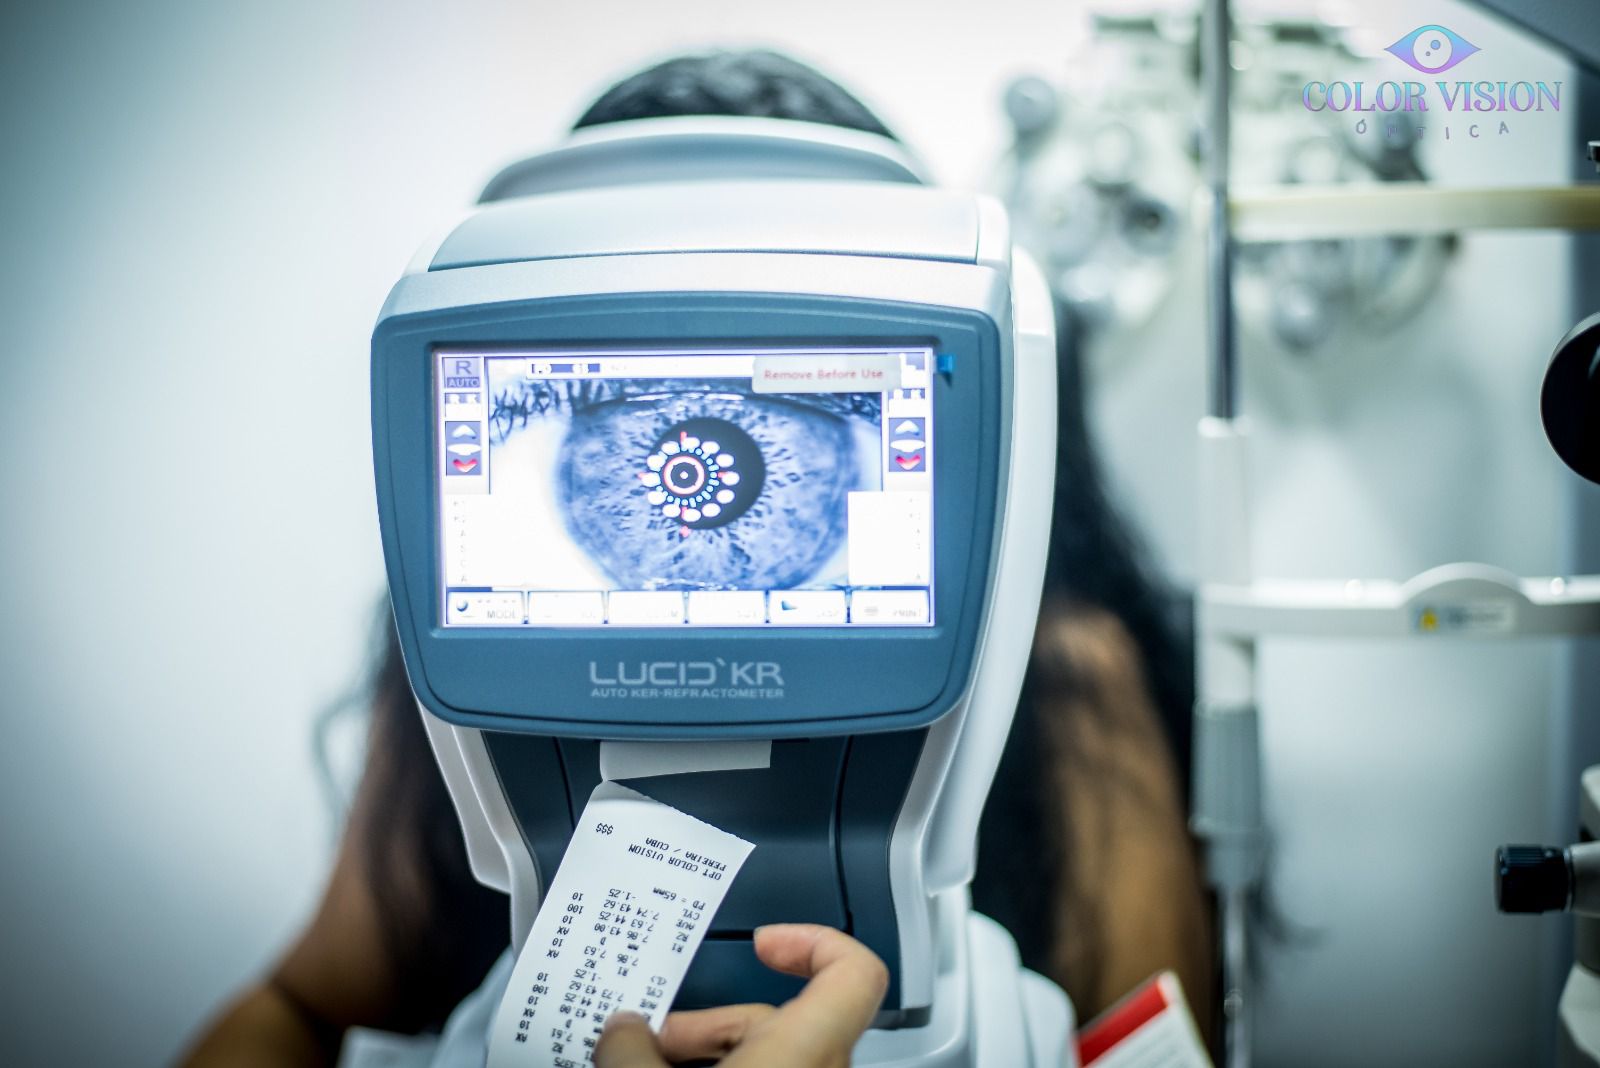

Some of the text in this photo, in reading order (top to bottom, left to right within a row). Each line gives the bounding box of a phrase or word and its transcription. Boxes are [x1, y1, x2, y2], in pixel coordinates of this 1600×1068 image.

[455, 360, 472, 375] R
[764, 368, 884, 380] Remove Before Use
[448, 378, 479, 388] AUTO
[590, 688, 785, 698] AUTO KER-REFRACTOMETER
[595, 822, 614, 836] $$$
[645, 837, 670, 851] CUBA
[667, 856, 699, 872] COLOR
[684, 850, 728, 872] PEREIRA
[702, 868, 722, 881] OPT
[571, 891, 584, 902] 10
[652, 887, 677, 901] 65mm
[603, 898, 632, 913] 43.62
[608, 888, 701, 921] CYL -1.25
[561, 914, 575, 925] 10
[635, 906, 660, 921] 7.74
[566, 903, 690, 942] R2 7.63 44.25 100
[593, 922, 622, 936] 43.00
[556, 925, 571, 936] AX
[551, 937, 564, 948] 10
[599, 936, 607, 946] D
[546, 948, 560, 959] AX
[583, 945, 607, 959] 7.63
[584, 958, 597, 969] R2
[536, 971, 549, 983] 10
[532, 983, 549, 996] 100
[527, 995, 540, 1006] 10
